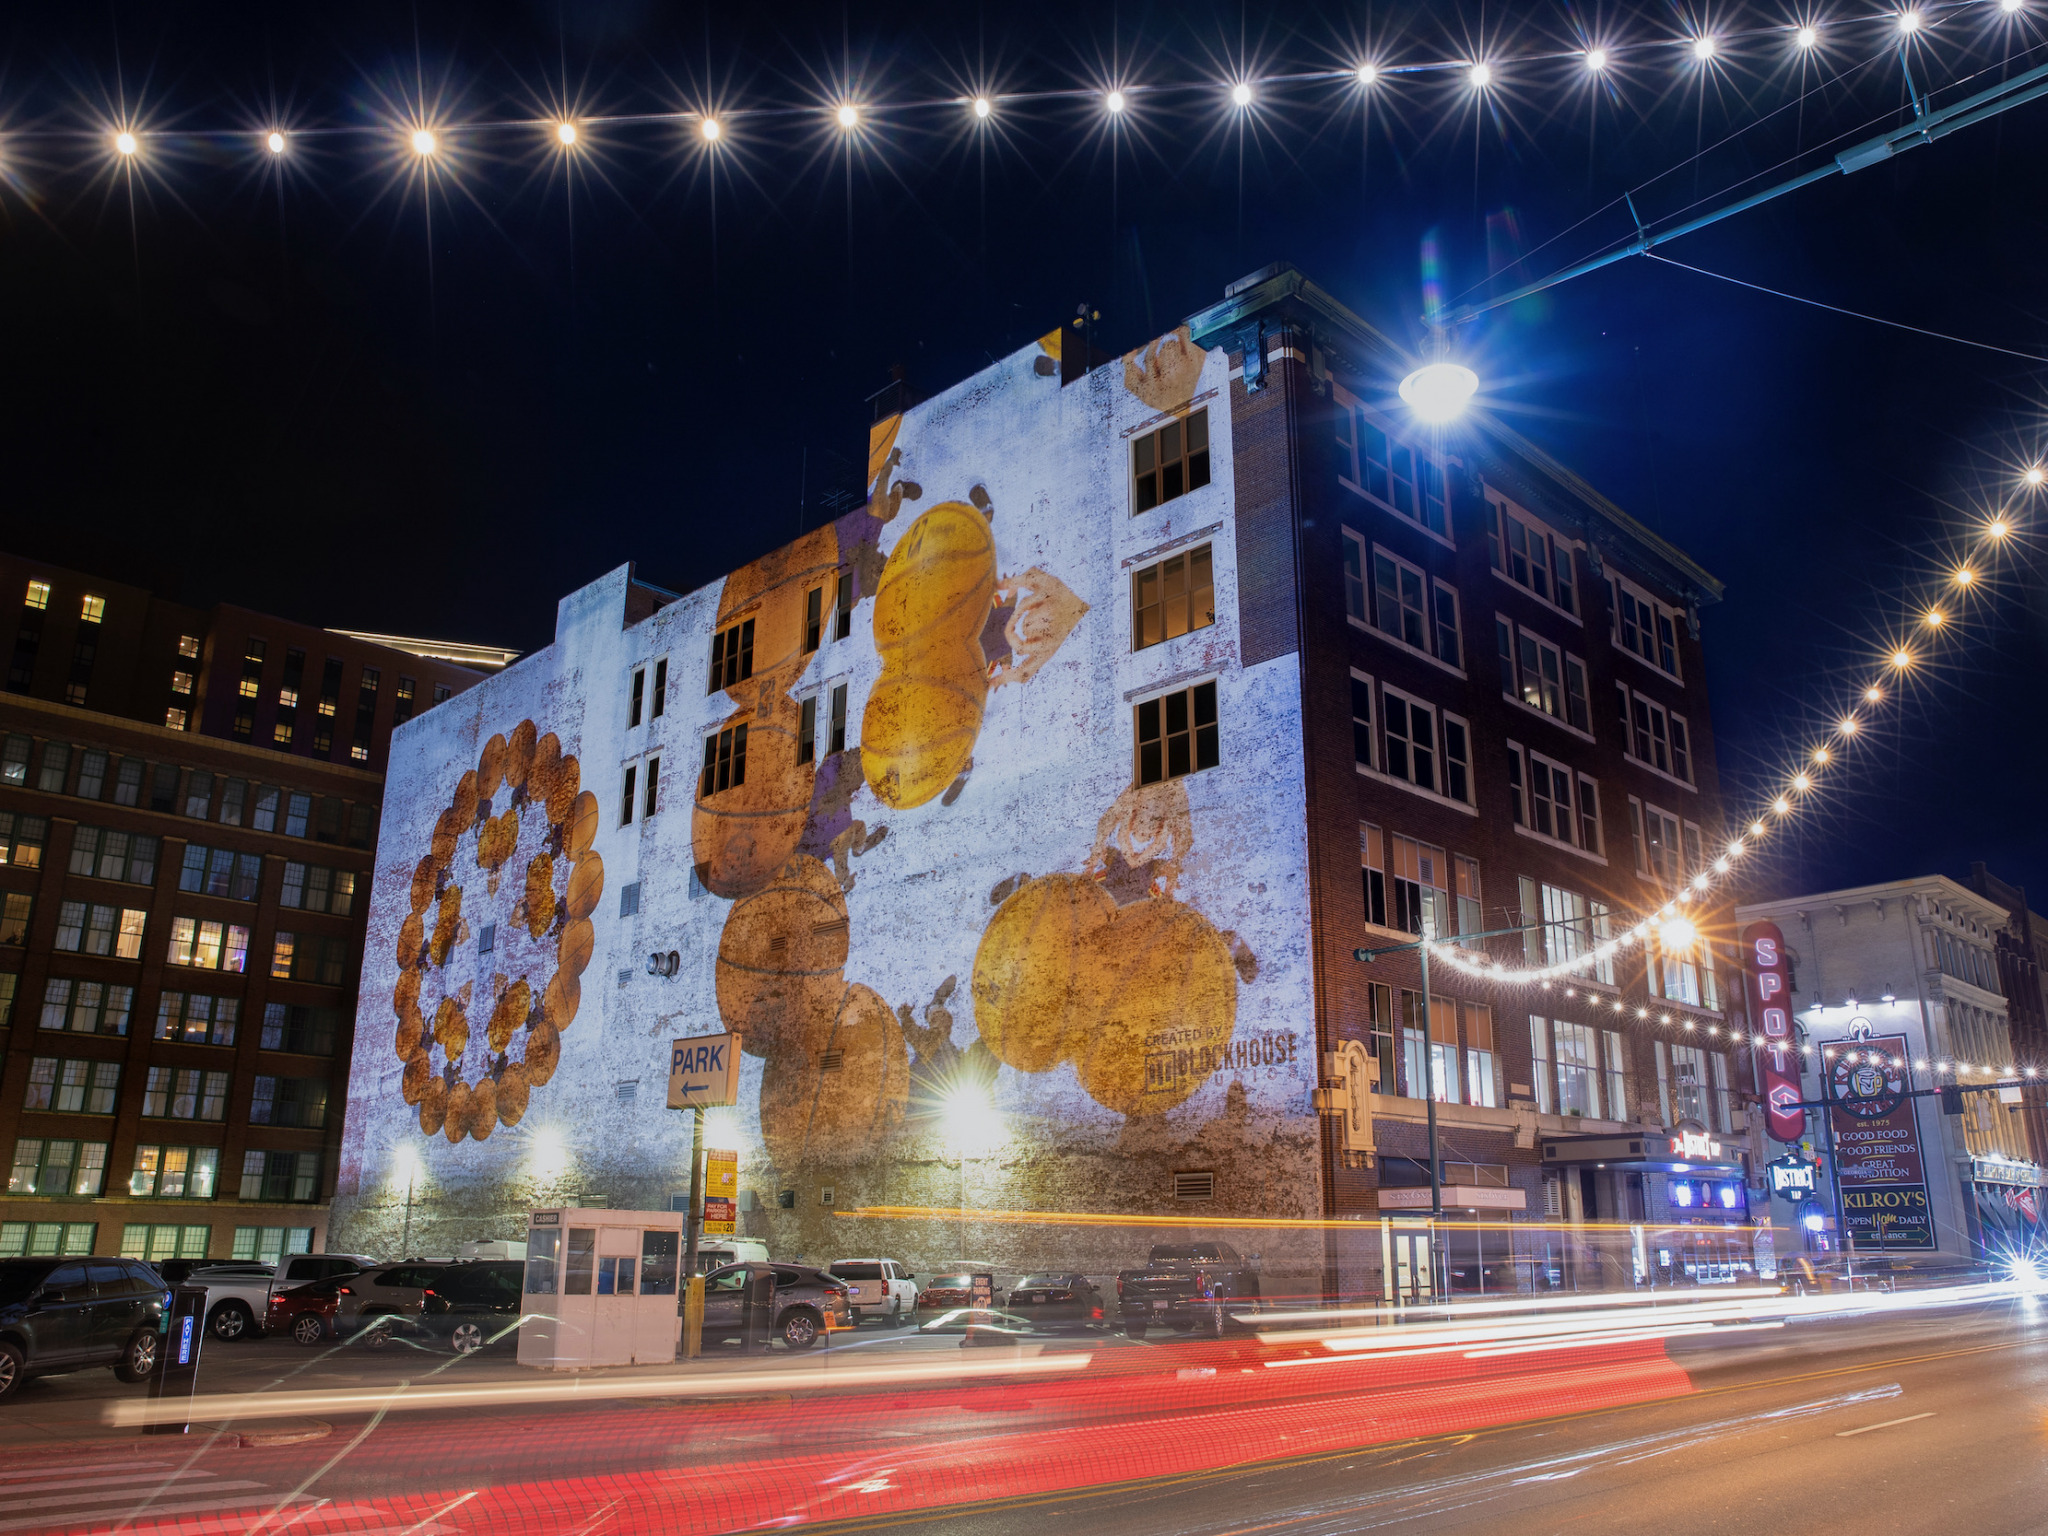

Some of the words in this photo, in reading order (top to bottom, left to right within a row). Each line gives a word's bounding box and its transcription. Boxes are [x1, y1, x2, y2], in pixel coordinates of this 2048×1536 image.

[1756, 938, 1787, 1072] SPOT
[1144, 1030, 1201, 1047] CREATED
[1206, 1026, 1222, 1039] BY
[672, 1044, 725, 1076] PARK
[1178, 1033, 1297, 1076] BLOCKHOUSE
[1872, 1119, 1890, 1127] 1975
[1842, 1131, 1875, 1141] GOOD
[1877, 1129, 1908, 1139] FOOD
[1874, 1144, 1916, 1154] FRIENDS
[1862, 1160, 1895, 1169] GREAT
[1773, 1165, 1814, 1190] DISTRICT
[1843, 1191, 1926, 1208] KILROY'S
[535, 1215, 558, 1223] CASHIER
[1847, 1217, 1872, 1226] OPEN
[1898, 1215, 1926, 1225] DAILY
[181, 1338, 189, 1361] HERE
